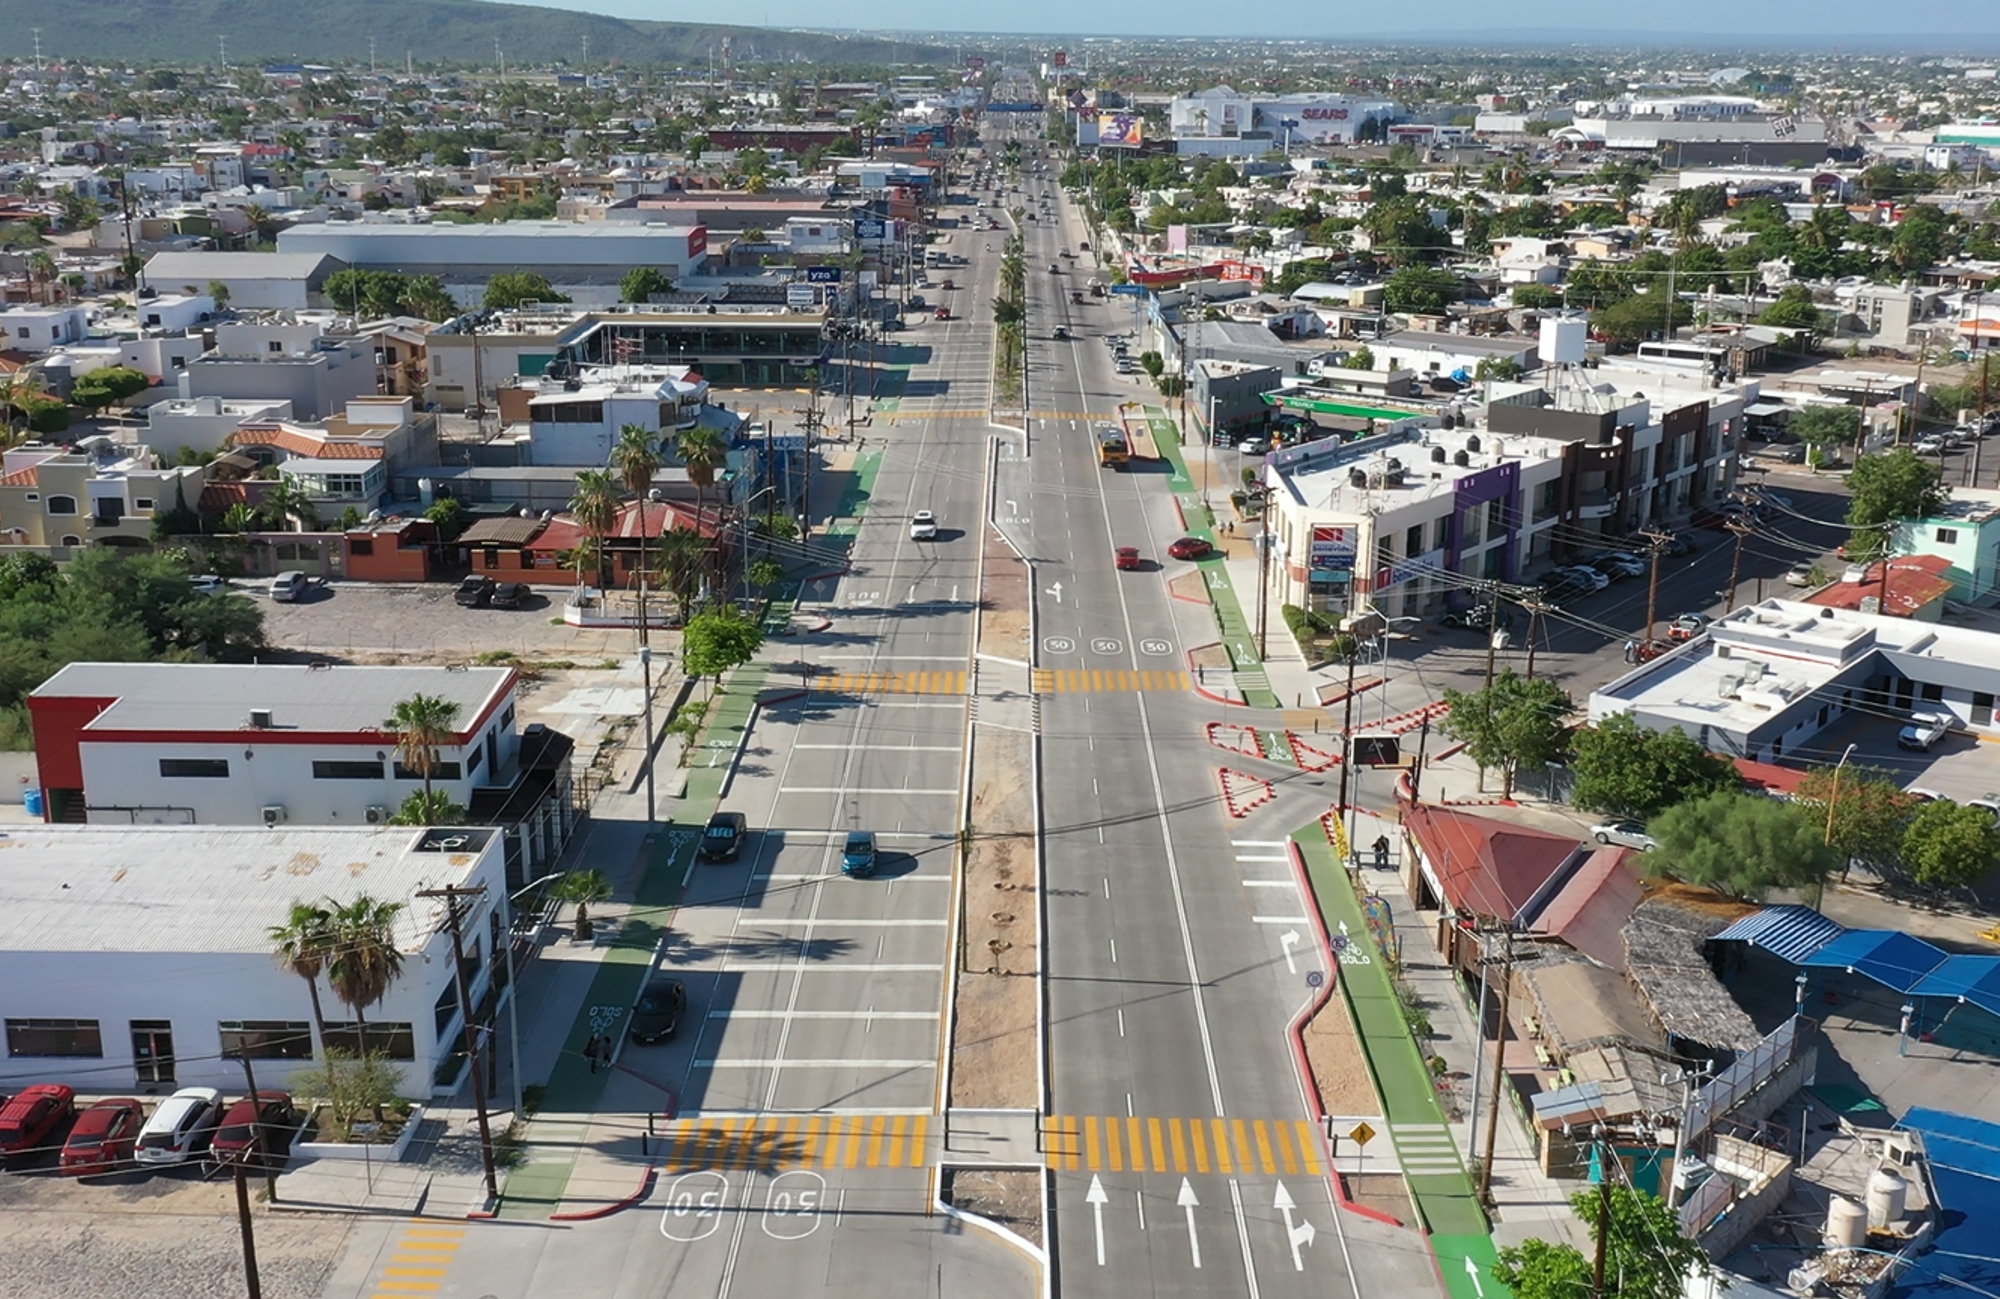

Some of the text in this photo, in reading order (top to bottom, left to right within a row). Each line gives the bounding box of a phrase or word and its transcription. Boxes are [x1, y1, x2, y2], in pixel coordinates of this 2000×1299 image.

[1302, 108, 1348, 120] SEARS
[811, 272, 831, 280] yza
[1339, 956, 1371, 964] SOLO
[589, 1006, 623, 1017] SOLO
